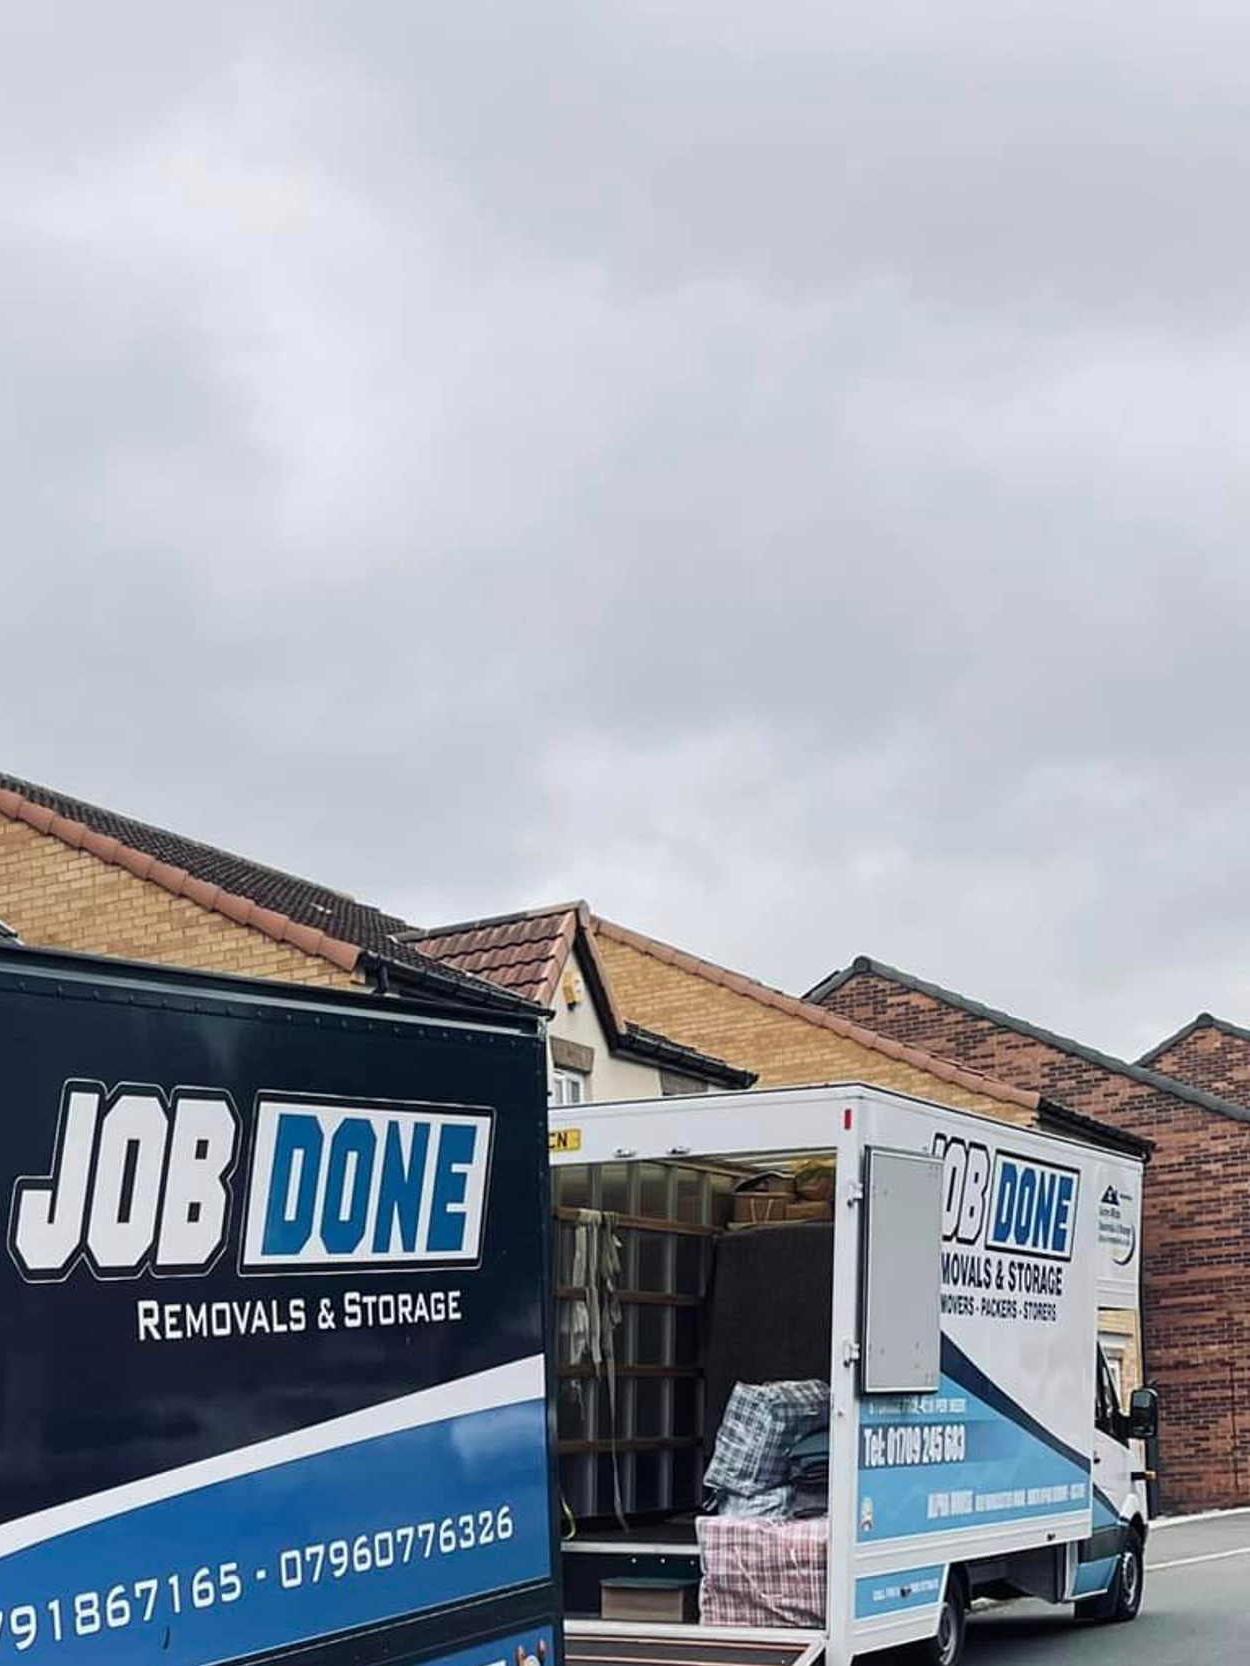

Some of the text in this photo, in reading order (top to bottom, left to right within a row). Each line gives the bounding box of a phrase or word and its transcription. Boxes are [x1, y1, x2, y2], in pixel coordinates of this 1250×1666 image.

[15, 1091, 478, 1270] JOB DONE
[932, 1132, 1073, 1252] OB DONE
[137, 1289, 462, 1342] REMOVALS & STORAGE
[941, 1252, 1063, 1296] MOVALS & STORAGE
[279, 1505, 514, 1589] 07960776326
